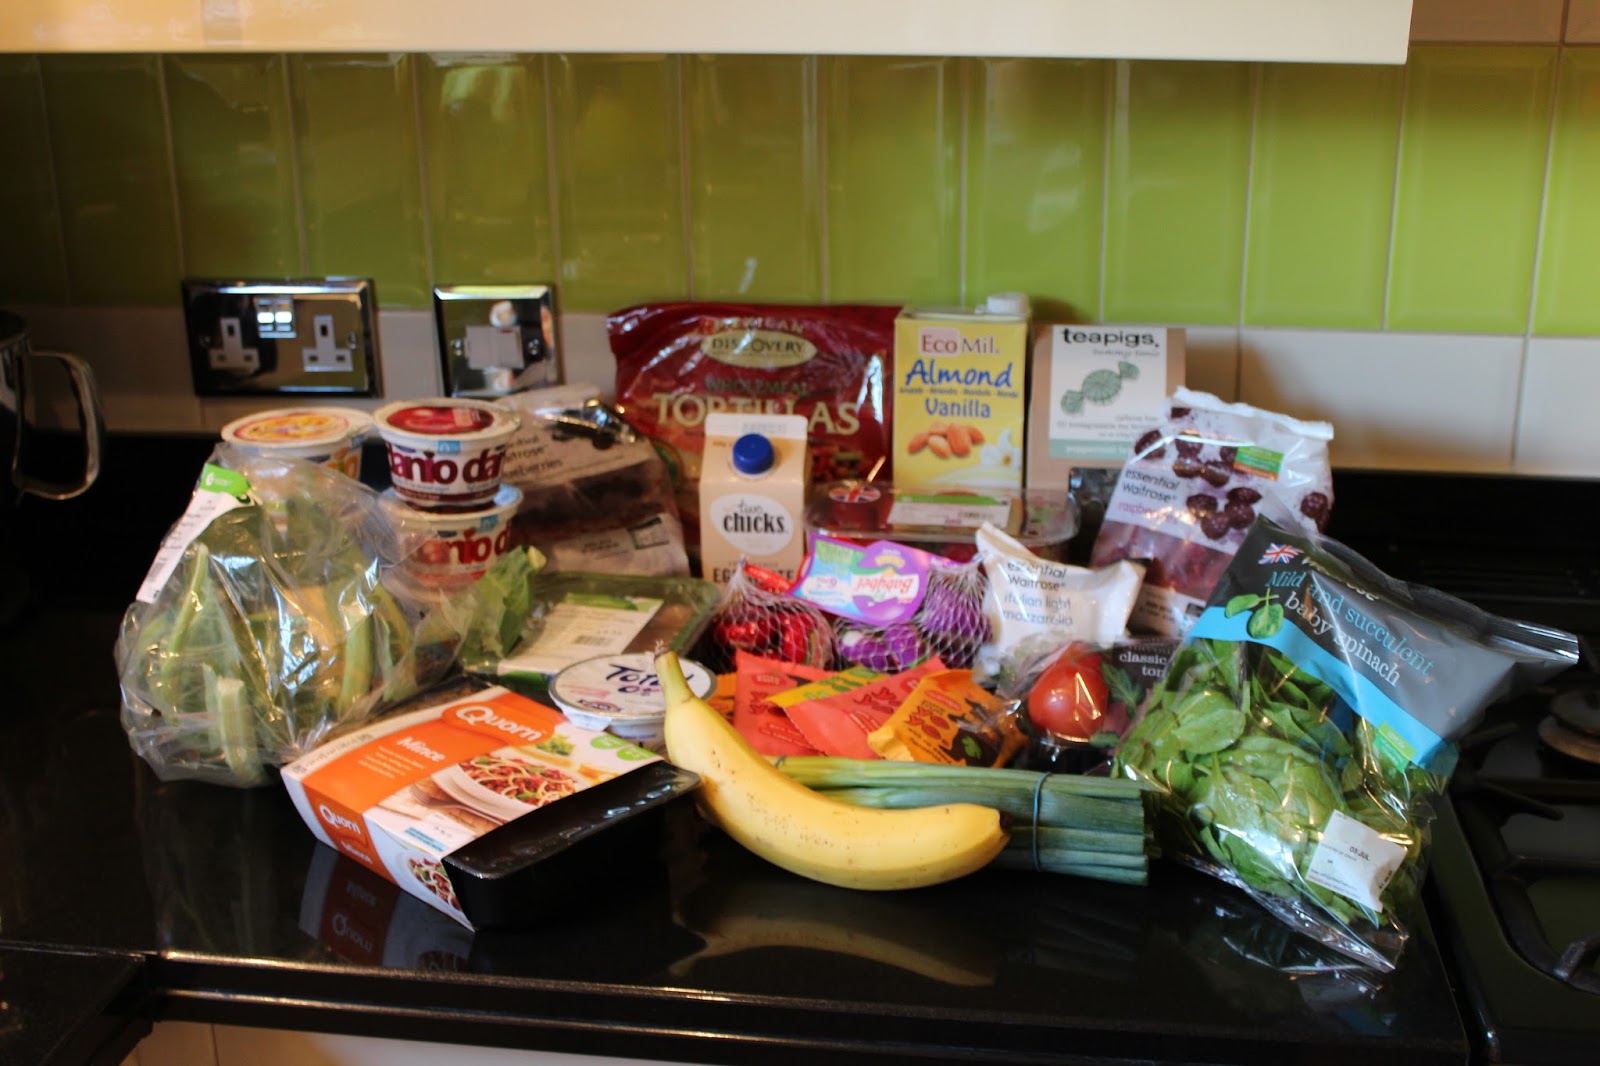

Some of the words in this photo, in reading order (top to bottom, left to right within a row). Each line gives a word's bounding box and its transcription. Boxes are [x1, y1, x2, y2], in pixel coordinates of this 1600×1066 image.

[711, 337, 804, 353] DISOVERY
[905, 358, 1014, 388] Almond
[925, 397, 992, 418] Vanilla
[1125, 468, 1181, 491] essential
[1007, 561, 1067, 579] essential
[1004, 592, 1043, 605] italian
[1045, 593, 1071, 610] light
[1265, 571, 1307, 588] Mild
[1307, 582, 1345, 615] and
[1345, 607, 1435, 676] succulent
[1284, 591, 1334, 635] baby
[1333, 630, 1401, 688] spinach
[1119, 651, 1167, 665] classic
[456, 705, 542, 742] Quorn
[396, 736, 446, 762] Mince
[319, 803, 361, 835] Quorn
